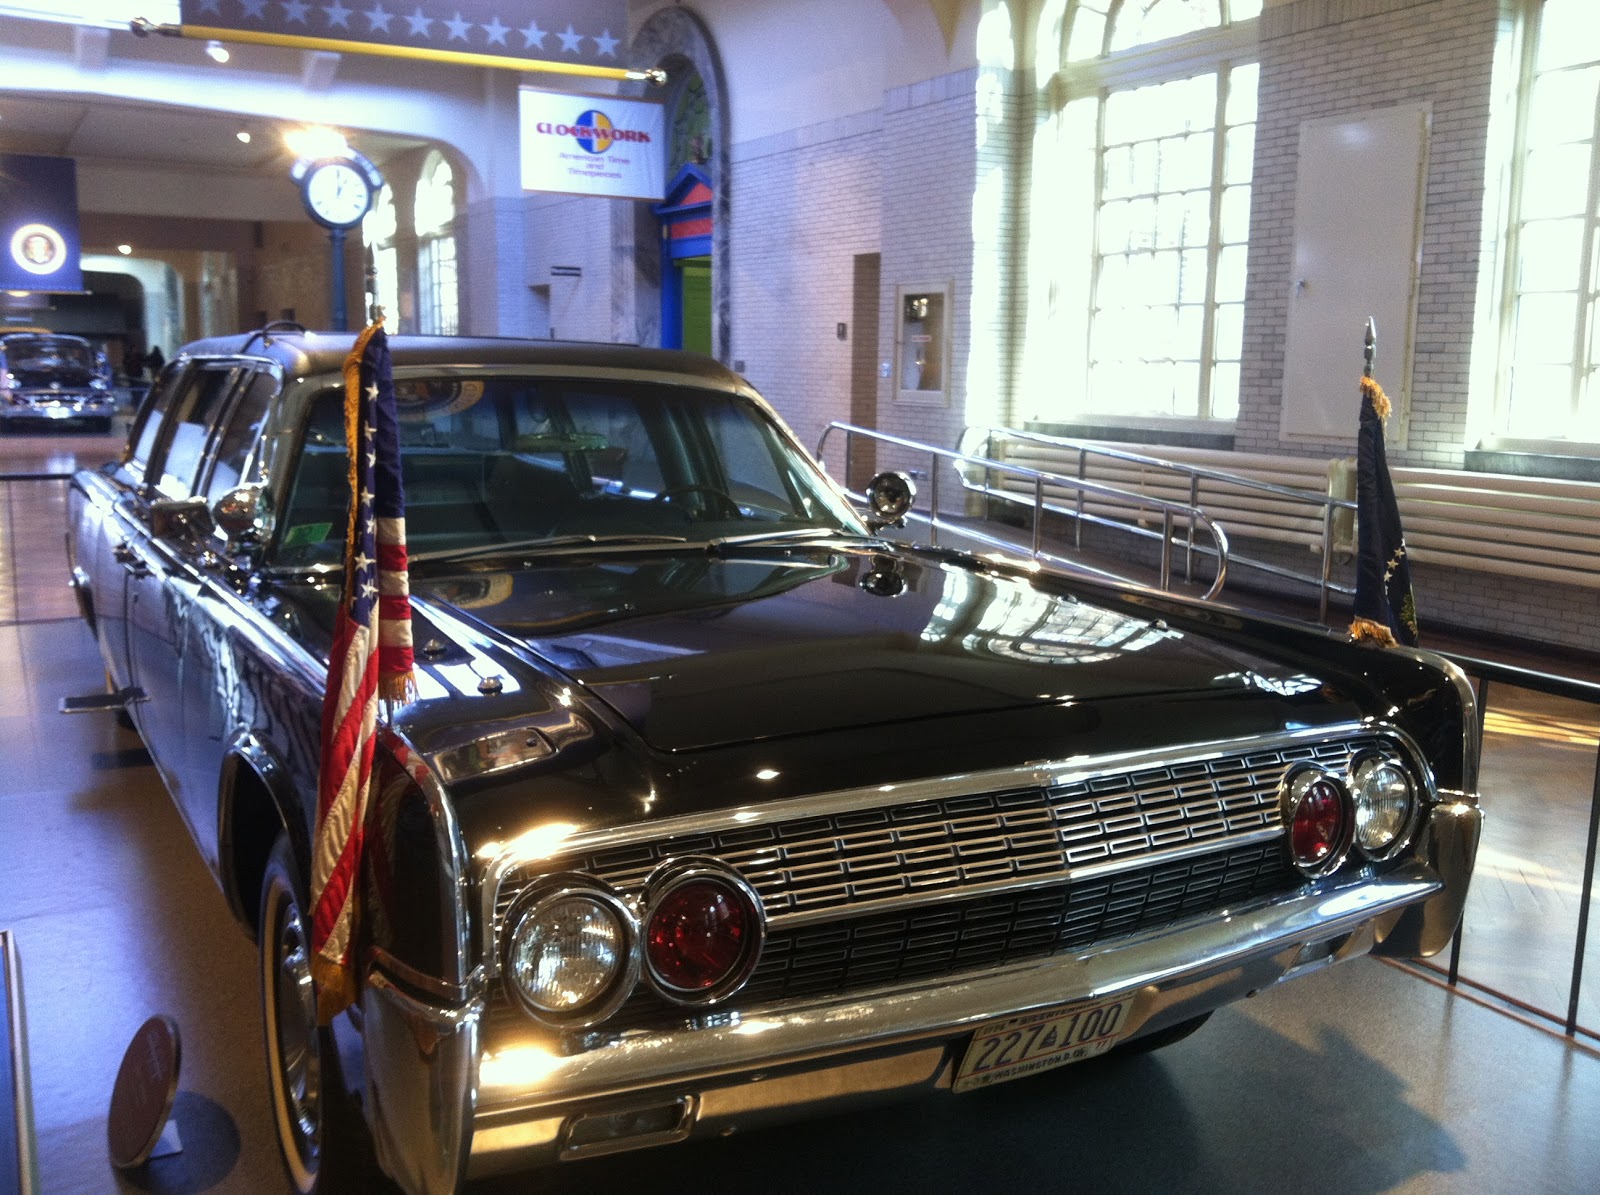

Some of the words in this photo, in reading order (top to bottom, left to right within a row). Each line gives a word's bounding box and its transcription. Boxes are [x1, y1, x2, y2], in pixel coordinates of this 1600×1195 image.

[536, 122, 651, 143] CLOCKWORK
[585, 162, 604, 170] and
[607, 155, 631, 165] Time
[973, 1023, 1046, 1072] 227
[1058, 1003, 1123, 1048] 100
